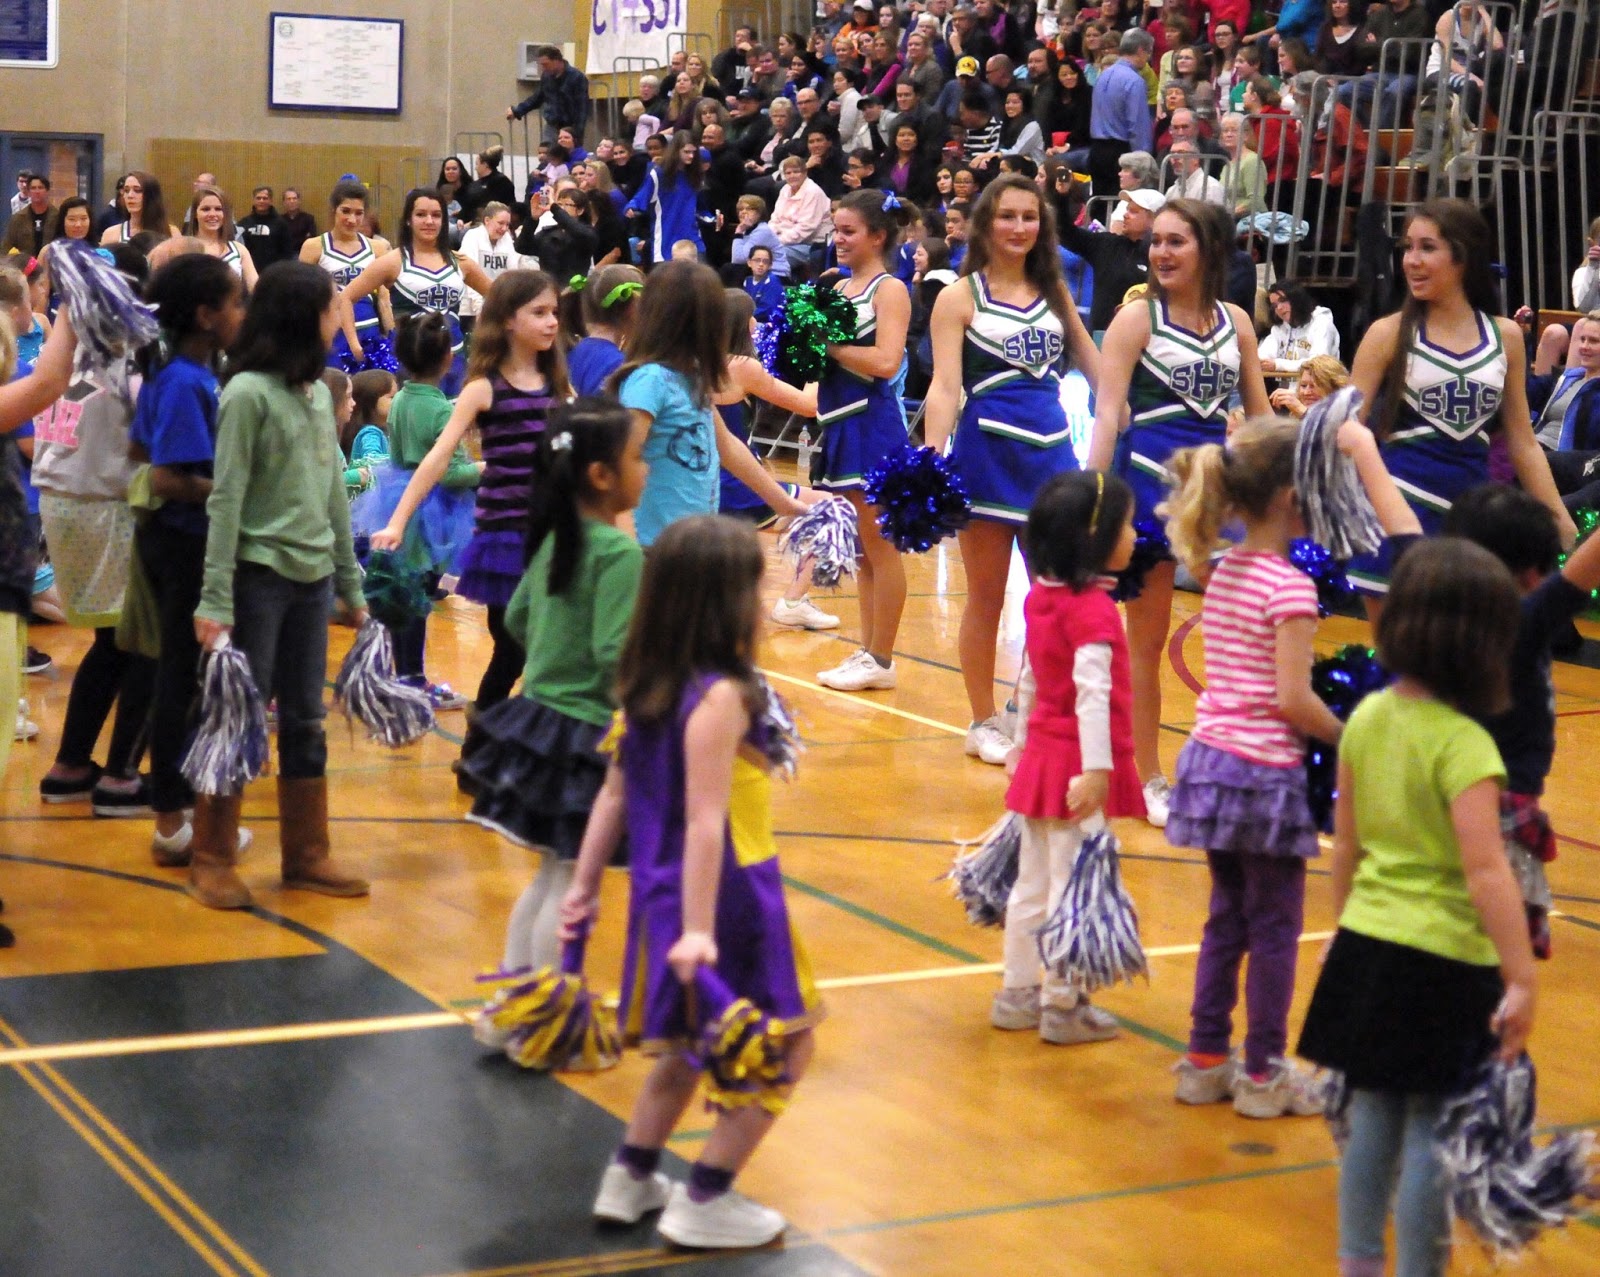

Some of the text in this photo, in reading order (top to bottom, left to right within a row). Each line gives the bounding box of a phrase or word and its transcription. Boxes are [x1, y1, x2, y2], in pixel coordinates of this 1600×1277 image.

[416, 285, 460, 310] SHS
[1003, 327, 1062, 364] SHS
[1170, 359, 1238, 400] SHS
[1420, 378, 1500, 424] SHS
